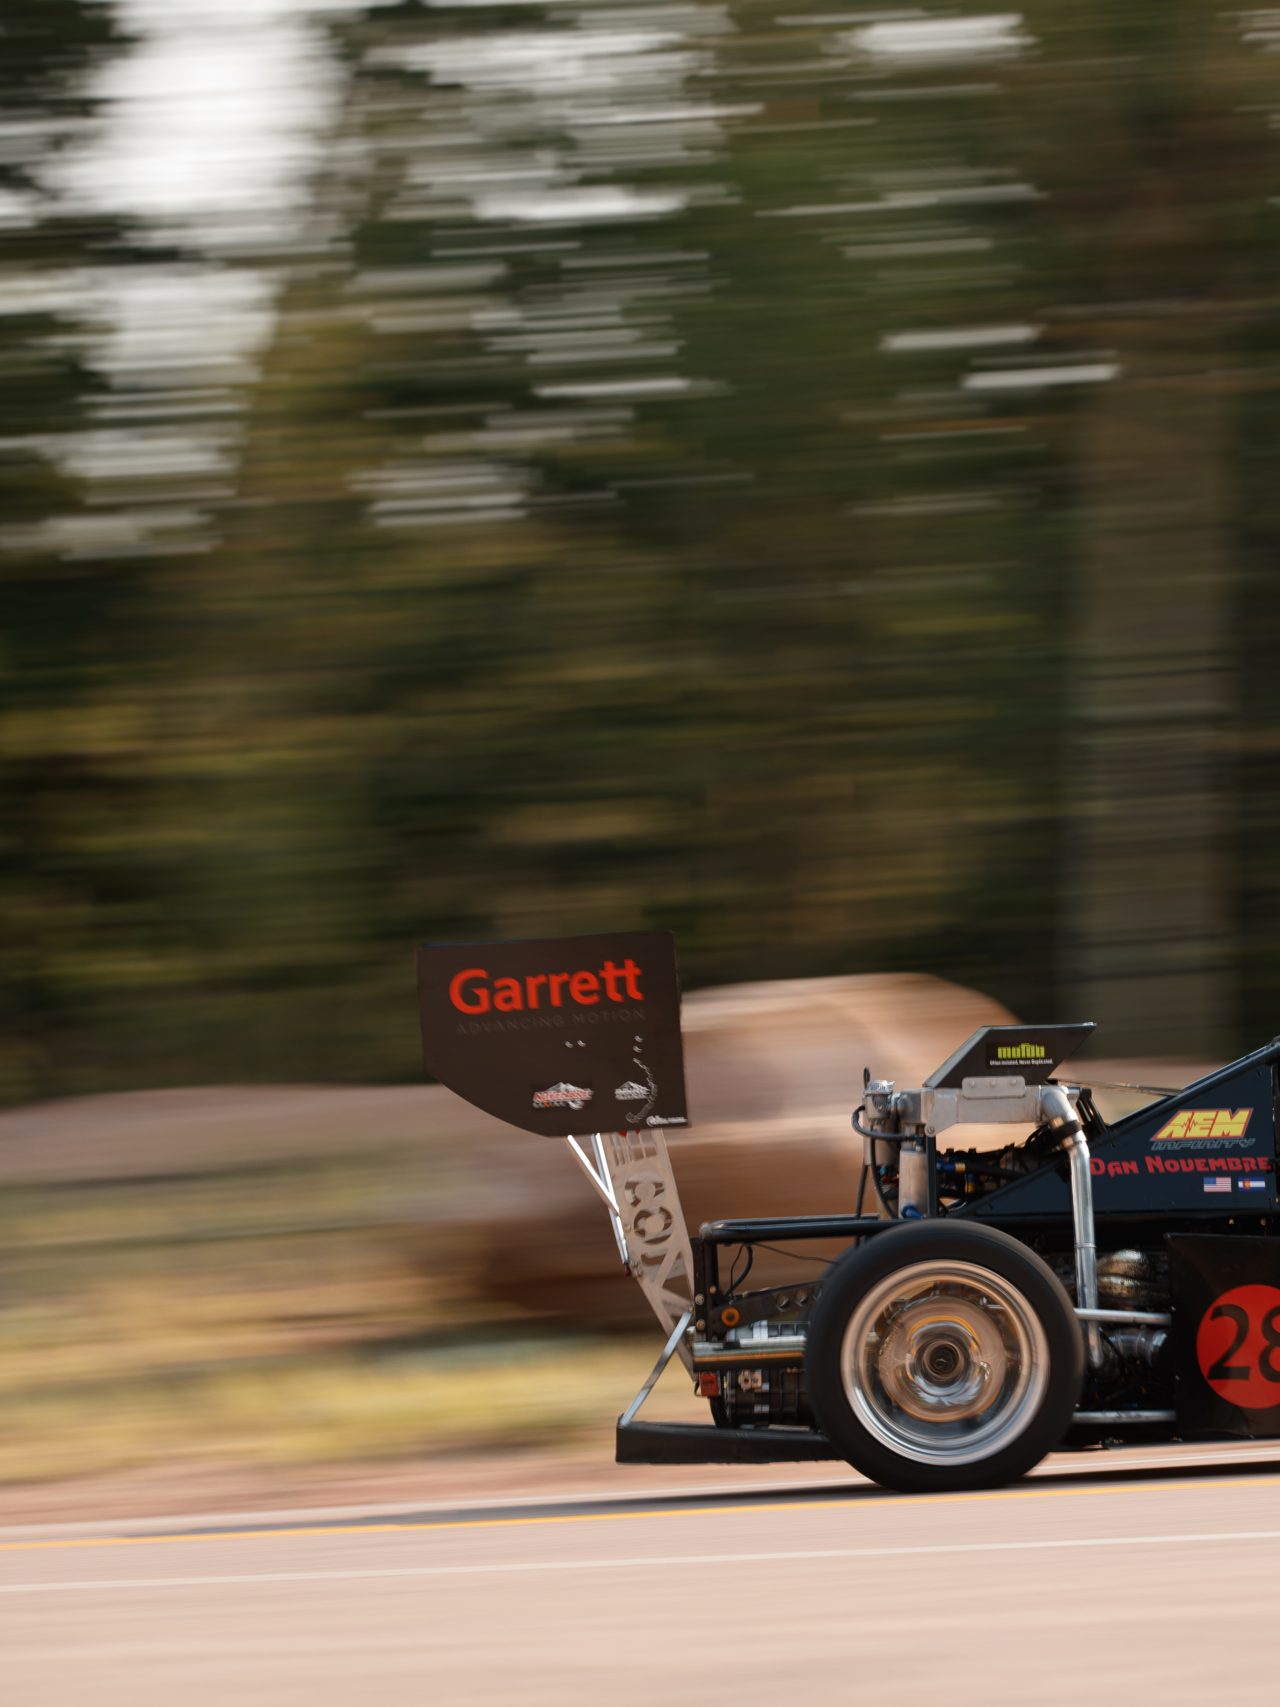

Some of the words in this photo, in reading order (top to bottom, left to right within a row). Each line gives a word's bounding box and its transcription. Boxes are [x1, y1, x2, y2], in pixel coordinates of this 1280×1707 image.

[449, 959, 645, 1014] Garrett
[456, 1014, 565, 1035] ADVANCING
[571, 1007, 646, 1025] MOTION
[1153, 1108, 1252, 1140] AEM
[1151, 1138, 1256, 1151] INFINITY
[1089, 1156, 1140, 1178] DAN
